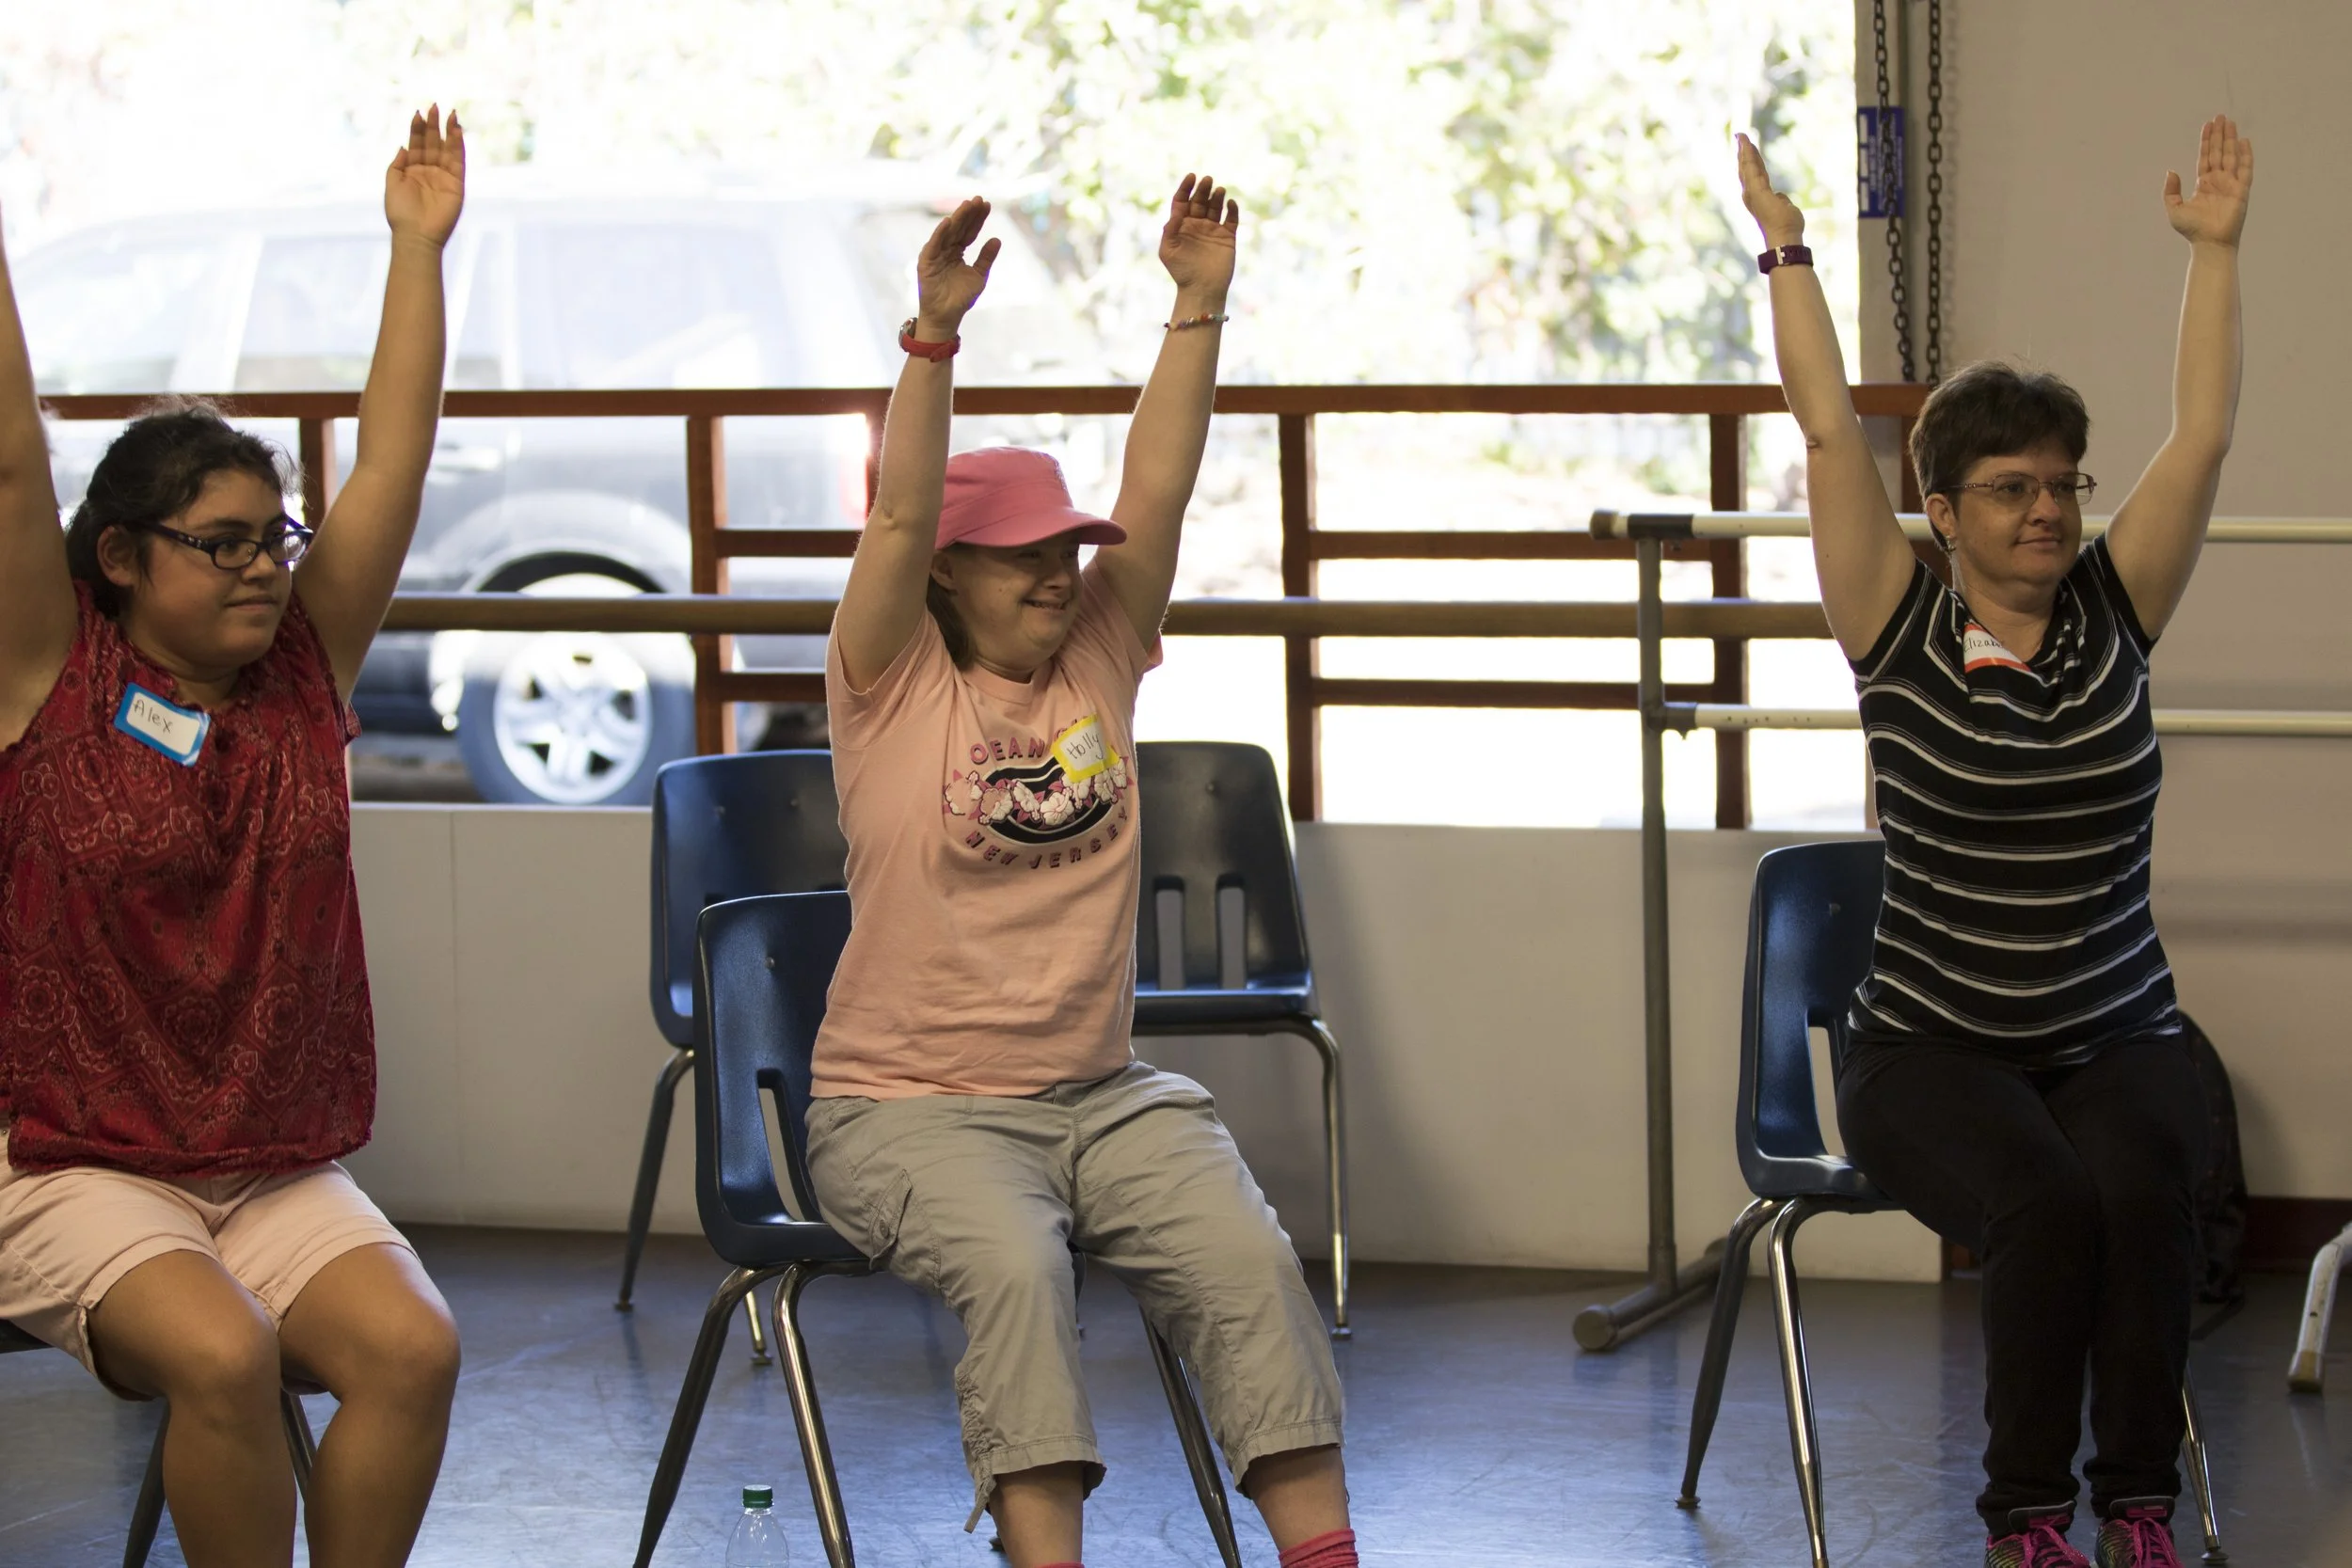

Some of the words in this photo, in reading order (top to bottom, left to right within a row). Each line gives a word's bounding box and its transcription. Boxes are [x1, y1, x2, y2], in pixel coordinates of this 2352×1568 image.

[134, 699, 173, 734] Alex
[1066, 732, 1104, 760] Holly
[965, 830, 1019, 866] NEW
[1028, 805, 1128, 869] JERSEY
